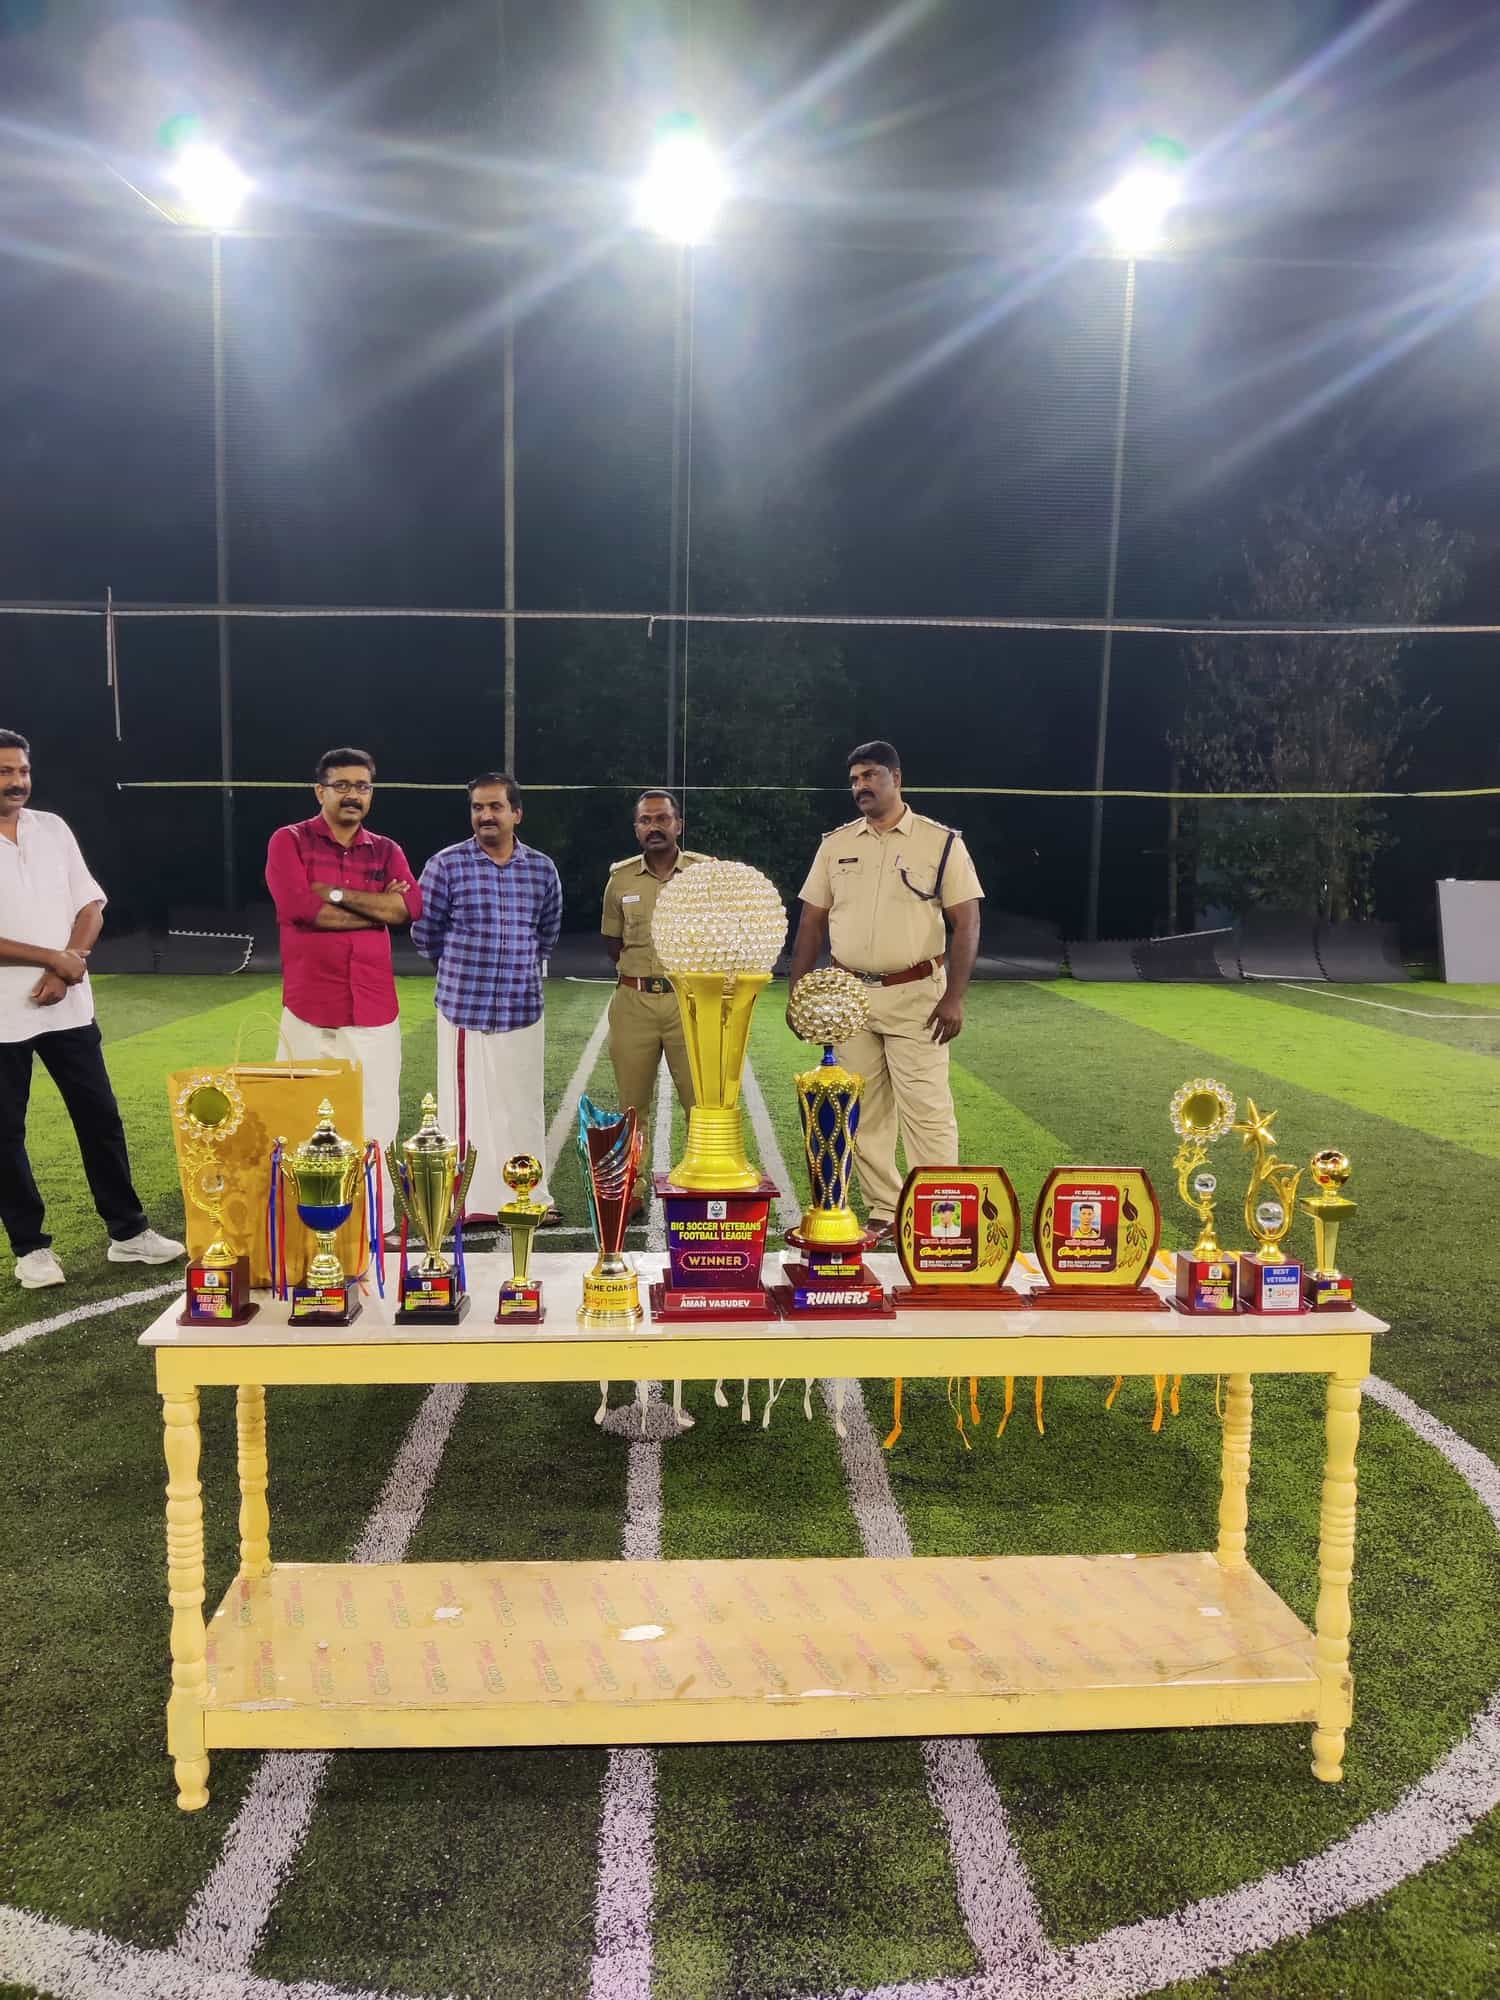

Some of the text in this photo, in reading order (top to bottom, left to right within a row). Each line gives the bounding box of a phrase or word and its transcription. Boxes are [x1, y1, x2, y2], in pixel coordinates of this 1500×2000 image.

[671, 1222, 761, 1230] BIG SOCCER VETERANS
[679, 1231, 752, 1240] FOOTBALL LEAGUE
[688, 1256, 742, 1266] WINNER
[806, 1291, 870, 1306] RUNNERS
